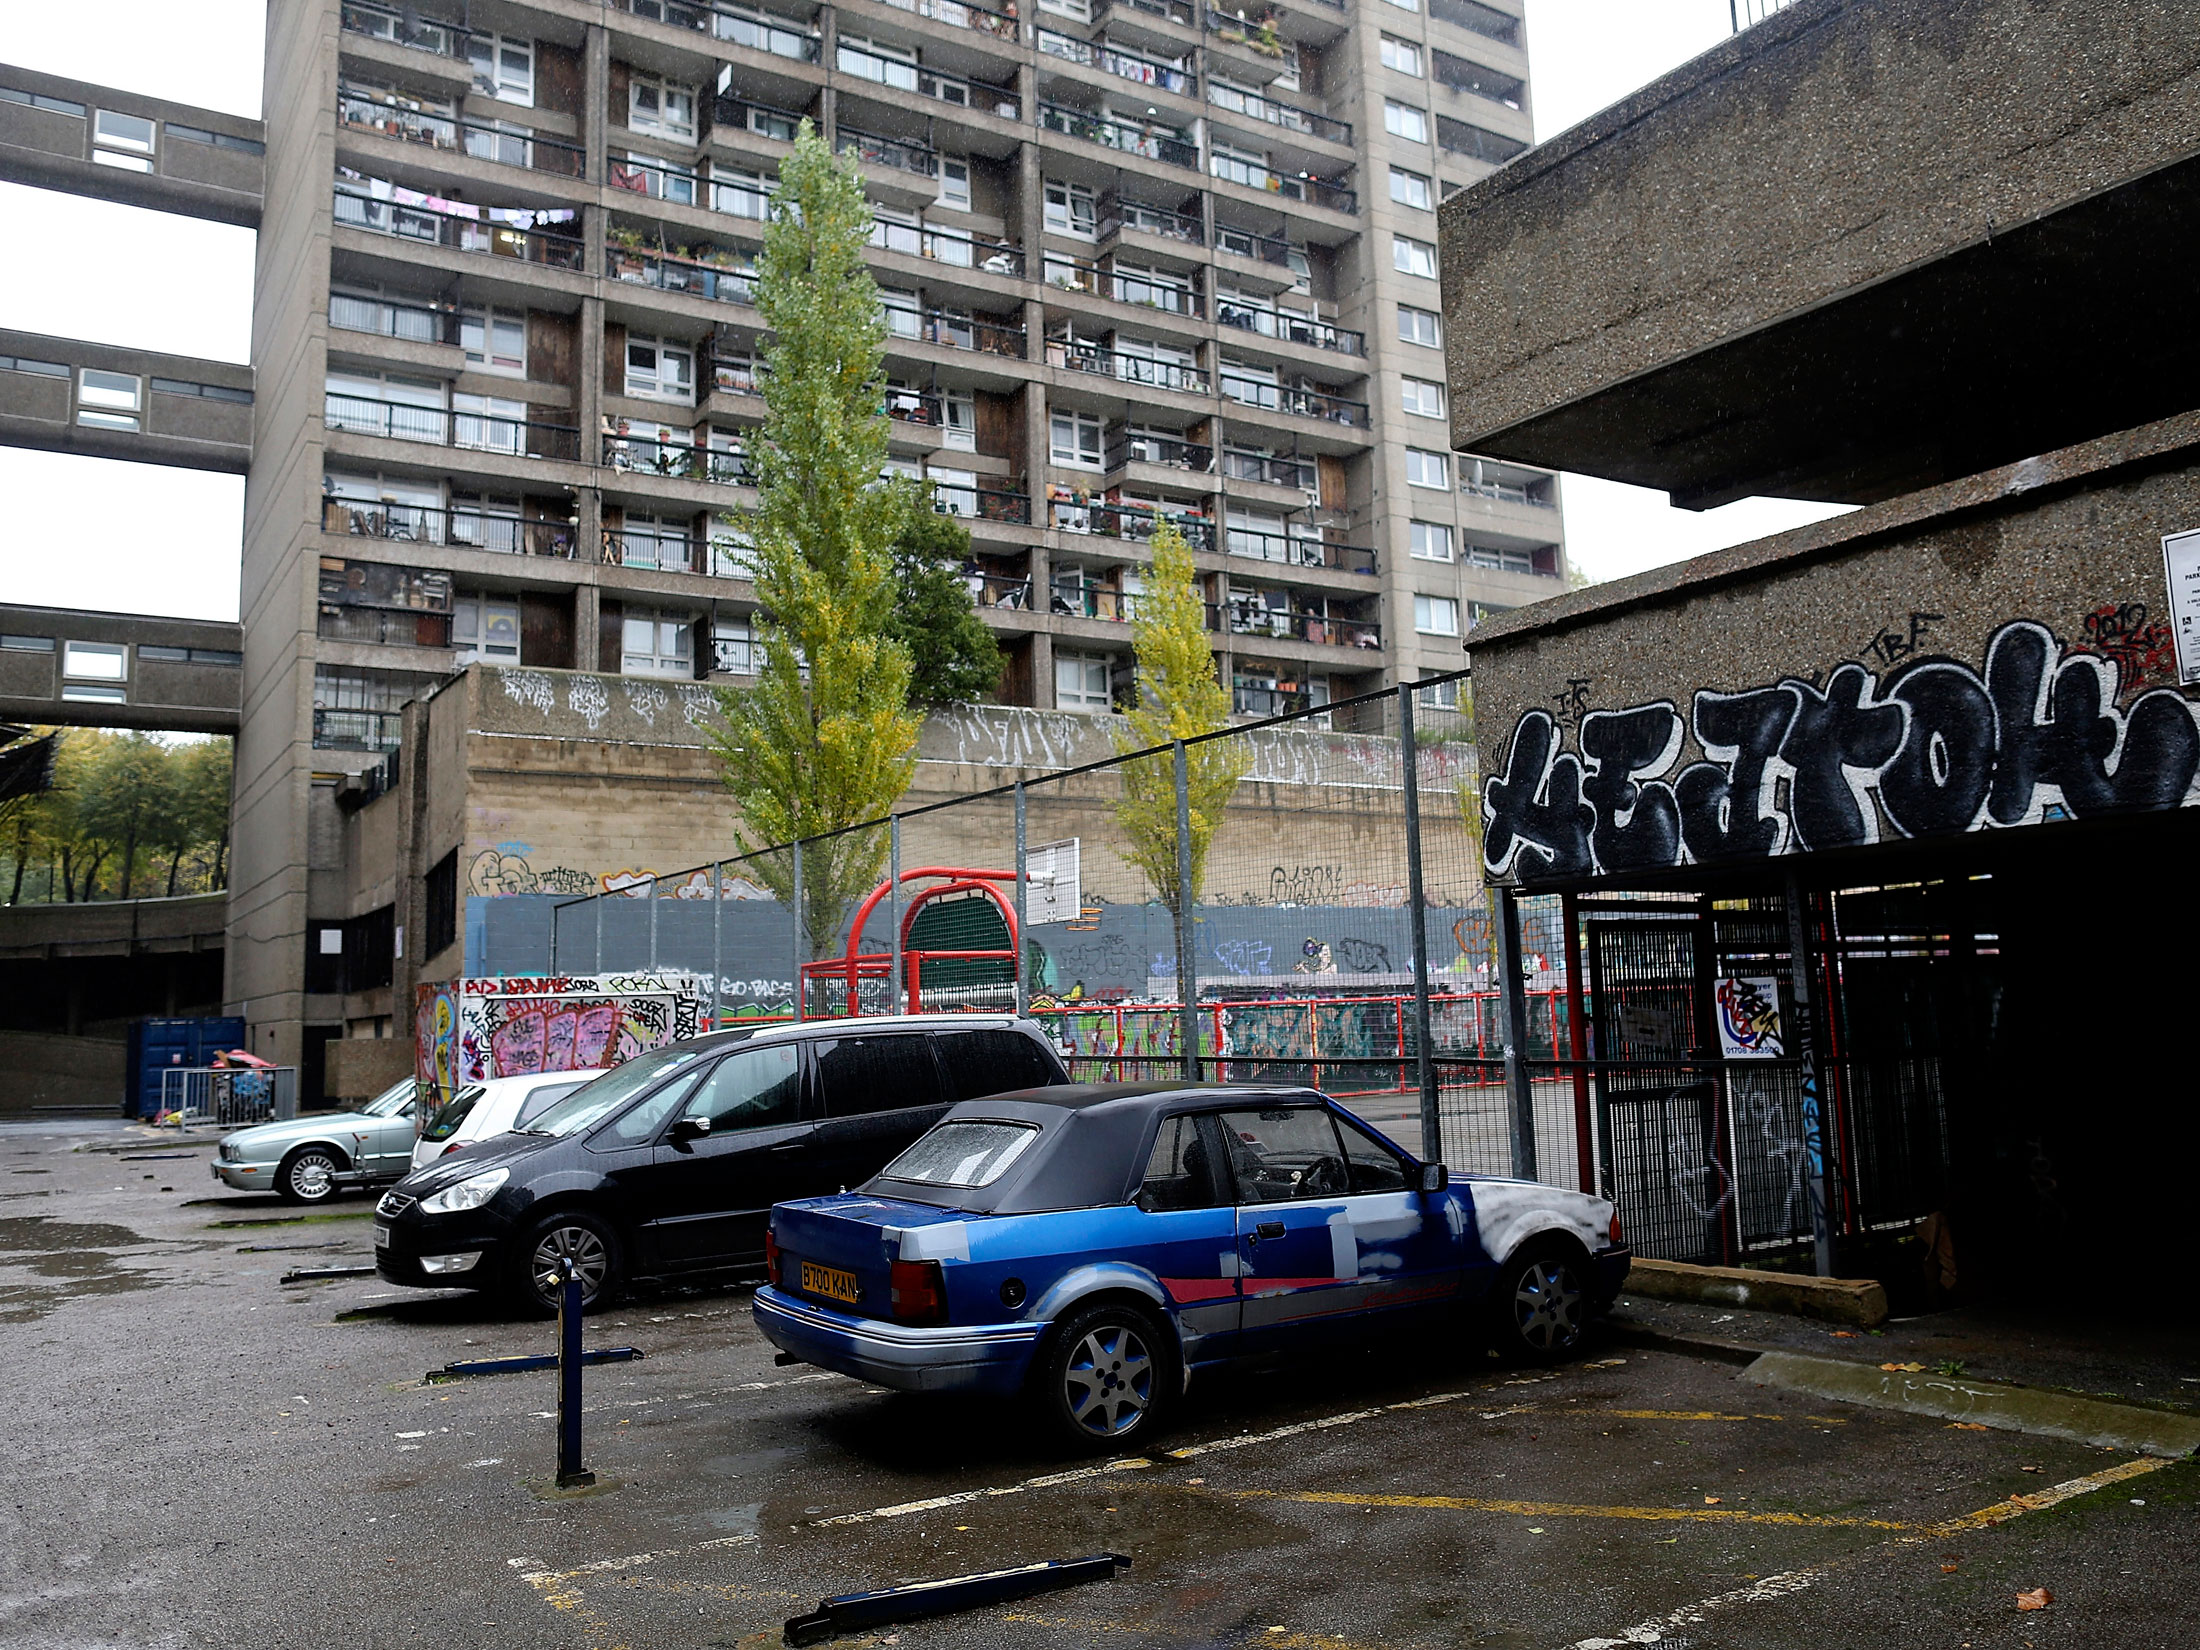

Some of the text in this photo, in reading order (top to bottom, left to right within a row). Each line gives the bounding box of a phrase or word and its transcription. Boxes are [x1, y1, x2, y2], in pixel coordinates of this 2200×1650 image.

[2083, 602, 2150, 646] 2012
[803, 1265, 856, 1300] B700 KAN
